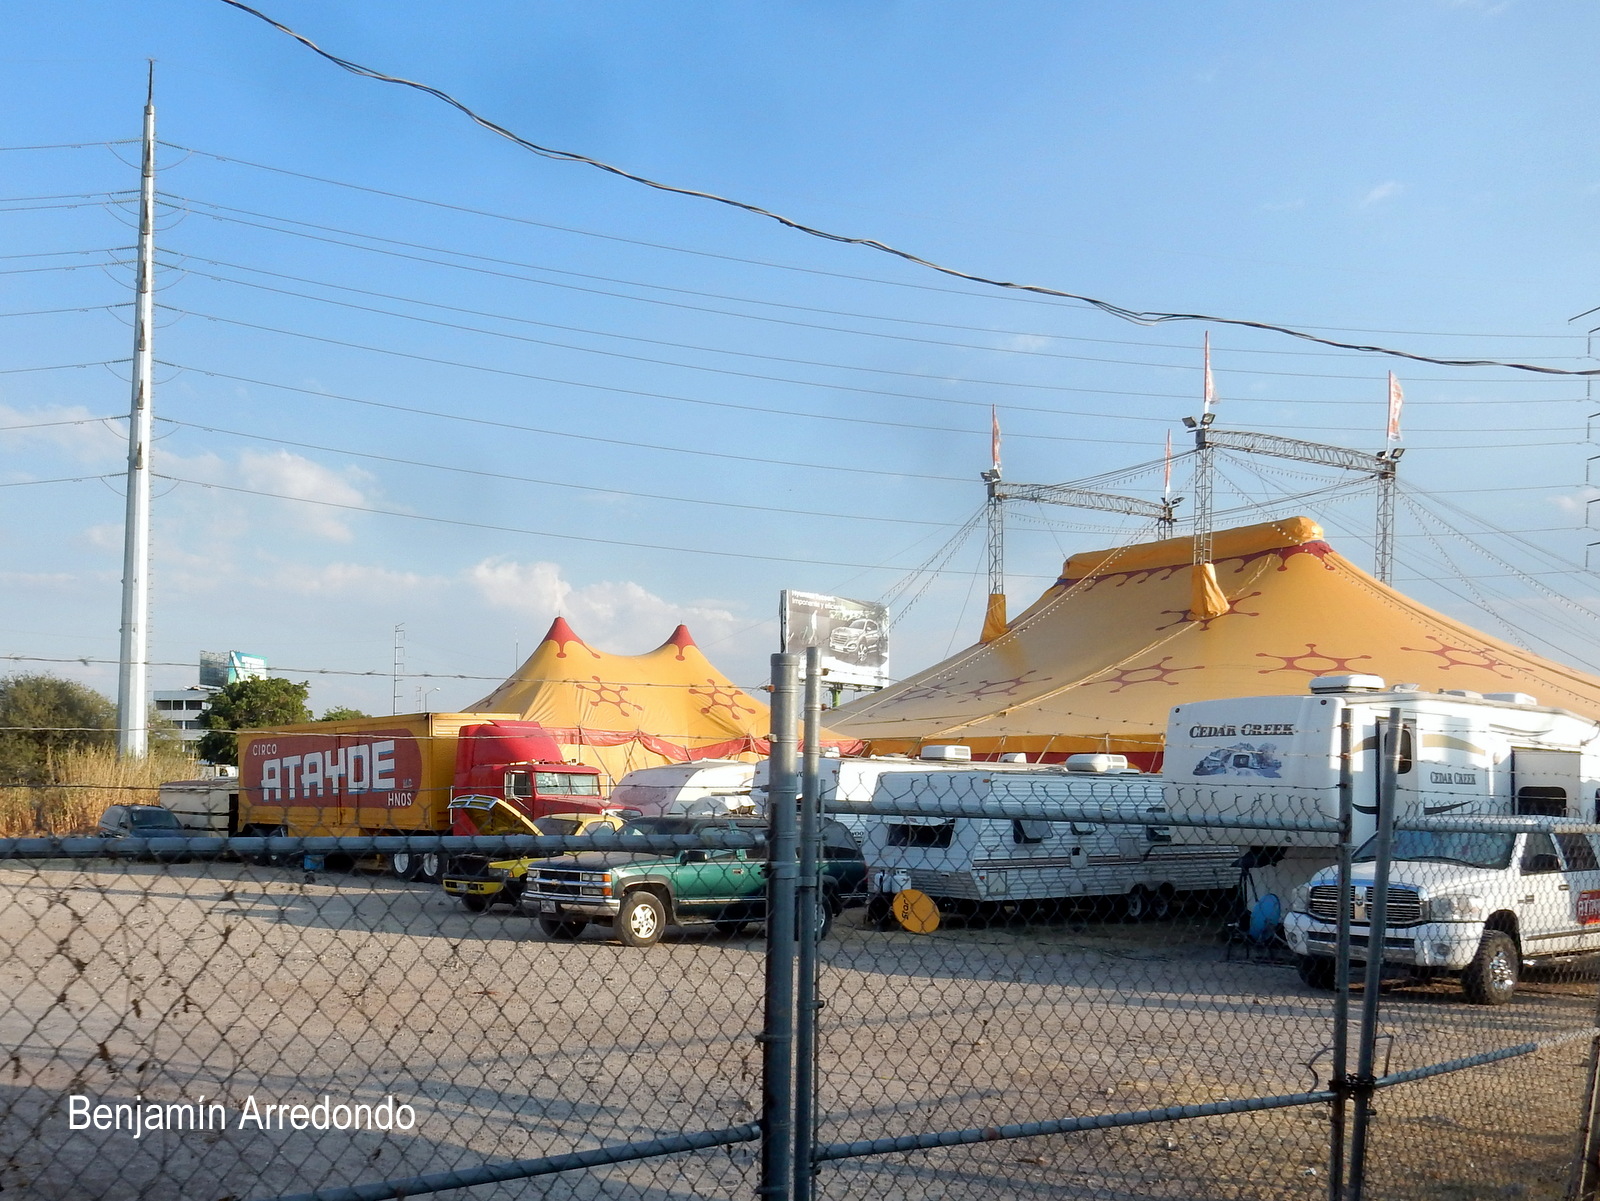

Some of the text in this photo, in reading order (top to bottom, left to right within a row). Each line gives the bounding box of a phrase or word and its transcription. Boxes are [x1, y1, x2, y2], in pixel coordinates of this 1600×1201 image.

[1189, 723, 1295, 738] CEDAR CREEK
[252, 743, 278, 756] CIRCO
[260, 740, 396, 802] ATAYDE
[1430, 771, 1477, 785] CEDAR CREEK
[387, 791, 412, 807] HNOS
